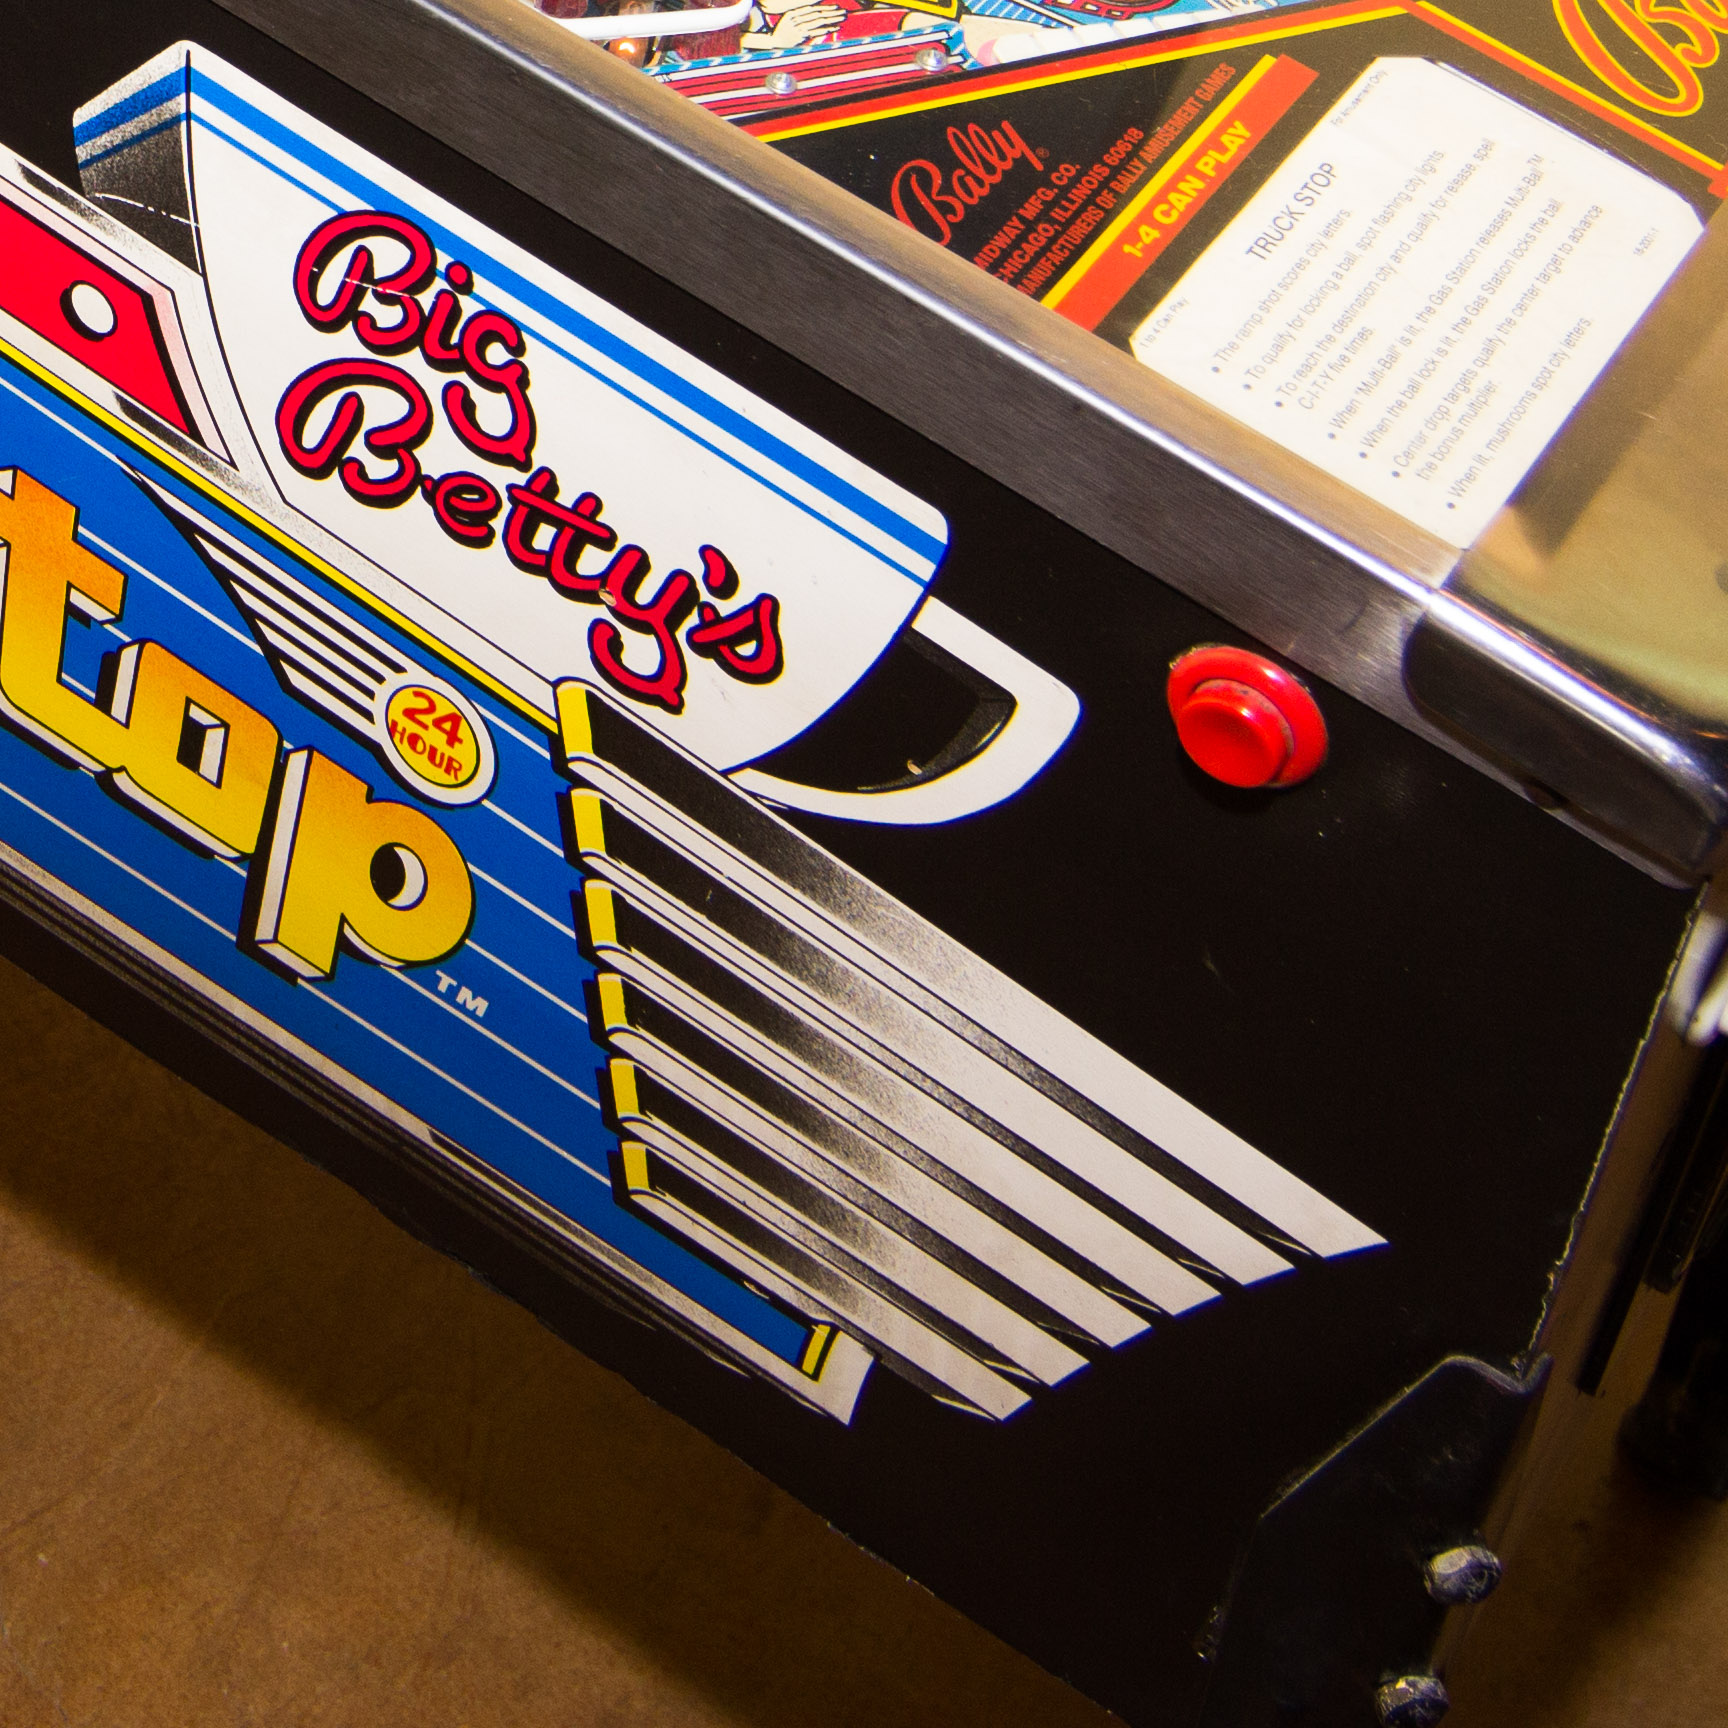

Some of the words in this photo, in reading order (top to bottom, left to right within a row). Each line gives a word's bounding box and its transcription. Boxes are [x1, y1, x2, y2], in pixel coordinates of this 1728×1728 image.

[1191, 61, 1239, 101] GAMES
[1134, 96, 1207, 163] AMUSEMENT
[890, 117, 1045, 247] Bally
[1015, 182, 1060, 219] MFG.
[1046, 158, 1082, 186] CO.
[1046, 162, 1113, 222] ILLINOIS
[1106, 156, 1151, 194] BALLY
[1119, 223, 1162, 259] 1-4
[1148, 173, 1209, 226] CAN
[1192, 119, 1256, 177] PLAY
[1093, 188, 1122, 209] OF
[1244, 202, 1306, 263] TRUCK
[1290, 160, 1342, 208] STOP
[1538, 195, 1565, 218] ball.
[1471, 205, 1514, 249] releases
[1526, 214, 1551, 234] the
[1256, 327, 1298, 366] qualify
[1284, 312, 1309, 332] for
[1297, 276, 1341, 318] locking
[1335, 248, 1364, 273] ball,
[1353, 225, 1384, 253] spot
[1371, 189, 1414, 230] flashing
[1401, 173, 1427, 195] city
[1414, 145, 1450, 178] lights.
[1291, 348, 1323, 379] reach
[1313, 331, 1338, 353] the
[1328, 279, 1381, 335] destination
[1371, 261, 1398, 284] city
[1386, 239, 1413, 264] and
[1403, 208, 1441, 245] qualify
[1428, 193, 1451, 212] for
[1440, 158, 1482, 199] release,
[1469, 137, 1499, 163] spell
[1506, 229, 1539, 261] locks
[1212, 337, 1241, 363] The
[1234, 311, 1267, 344] ramp
[1254, 287, 1284, 314] shot
[1276, 255, 1312, 291] scores
[1302, 237, 1329, 260] city
[1317, 204, 1355, 241] letters.
[1443, 245, 1483, 285] Station
[1478, 256, 1518, 296] Station
[1412, 302, 1438, 324] the
[1427, 281, 1455, 307] Gas
[1462, 292, 1490, 318] Gas
[293, 209, 538, 474] Big
[1391, 428, 1431, 469] Center
[1420, 401, 1455, 434] drop
[1441, 366, 1483, 408] targets
[1469, 332, 1508, 370] qualify
[1494, 314, 1518, 336] the
[1508, 282, 1544, 318] center
[1533, 252, 1569, 287] target
[1565, 203, 1605, 244] advance
[1402, 320, 1426, 339] lit,
[1438, 331, 1462, 350] lit,
[1448, 313, 1474, 335] the
[1558, 312, 1595, 350] letters.
[1296, 370, 1337, 411] C-I-T-Y
[1326, 351, 1352, 374] five
[1341, 321, 1376, 355] times.
[1413, 354, 1442, 381] lock
[1544, 346, 1573, 371] city
[1397, 376, 1425, 401] ball
[1528, 364, 1559, 393] spot
[1327, 396, 1363, 430] When
[1383, 396, 1409, 418] the
[1481, 387, 1539, 452] mushrooms
[1358, 413, 1395, 450] When
[1413, 458, 1439, 482] the
[1428, 424, 1466, 463] bonus
[1454, 375, 1505, 430] multiplier.
[1470, 448, 1495, 468] lit,
[1445, 462, 1482, 499] When
[275, 357, 784, 715] Betty's
[402, 689, 465, 750] 24
[388, 719, 463, 782] HOUR
